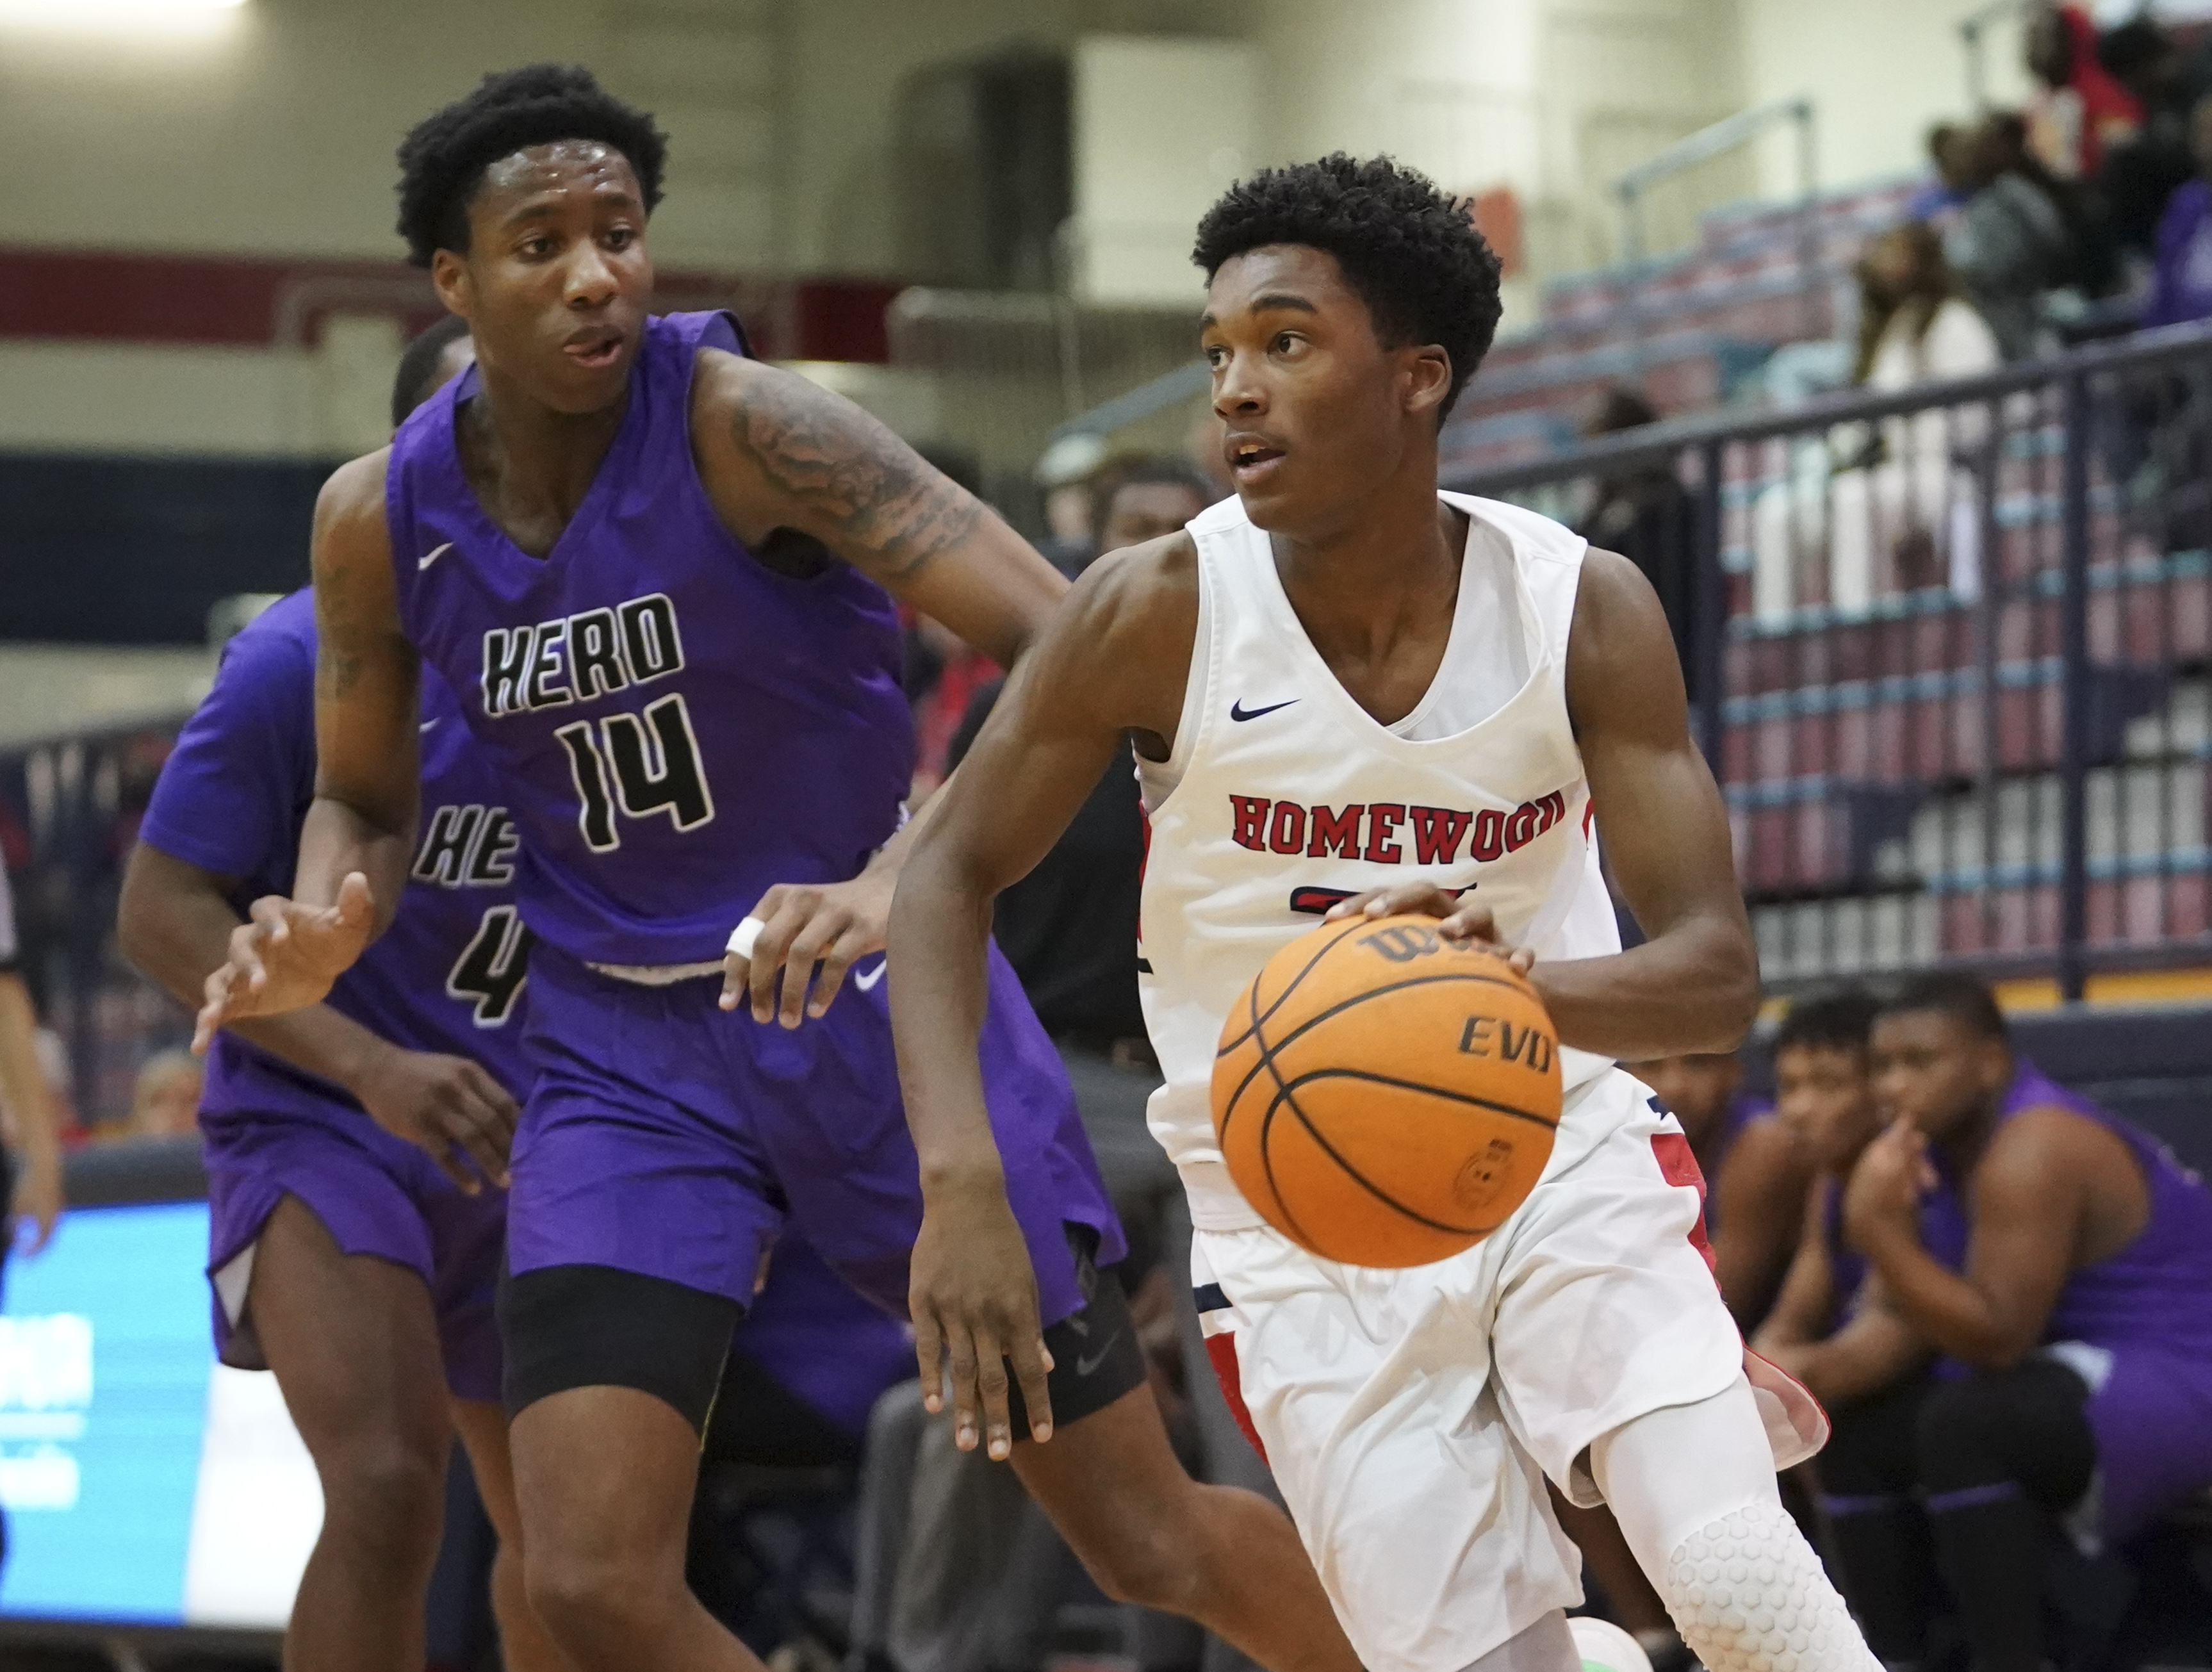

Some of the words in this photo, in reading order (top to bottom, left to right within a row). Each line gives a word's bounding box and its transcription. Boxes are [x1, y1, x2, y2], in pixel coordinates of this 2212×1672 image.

[482, 593, 684, 716] HERO
[554, 692, 715, 853] 14
[414, 805, 520, 888] HE
[1229, 790, 1565, 865] HOMEWOOD
[446, 905, 529, 1027] 4
[1457, 1014, 1551, 1075] EVO
